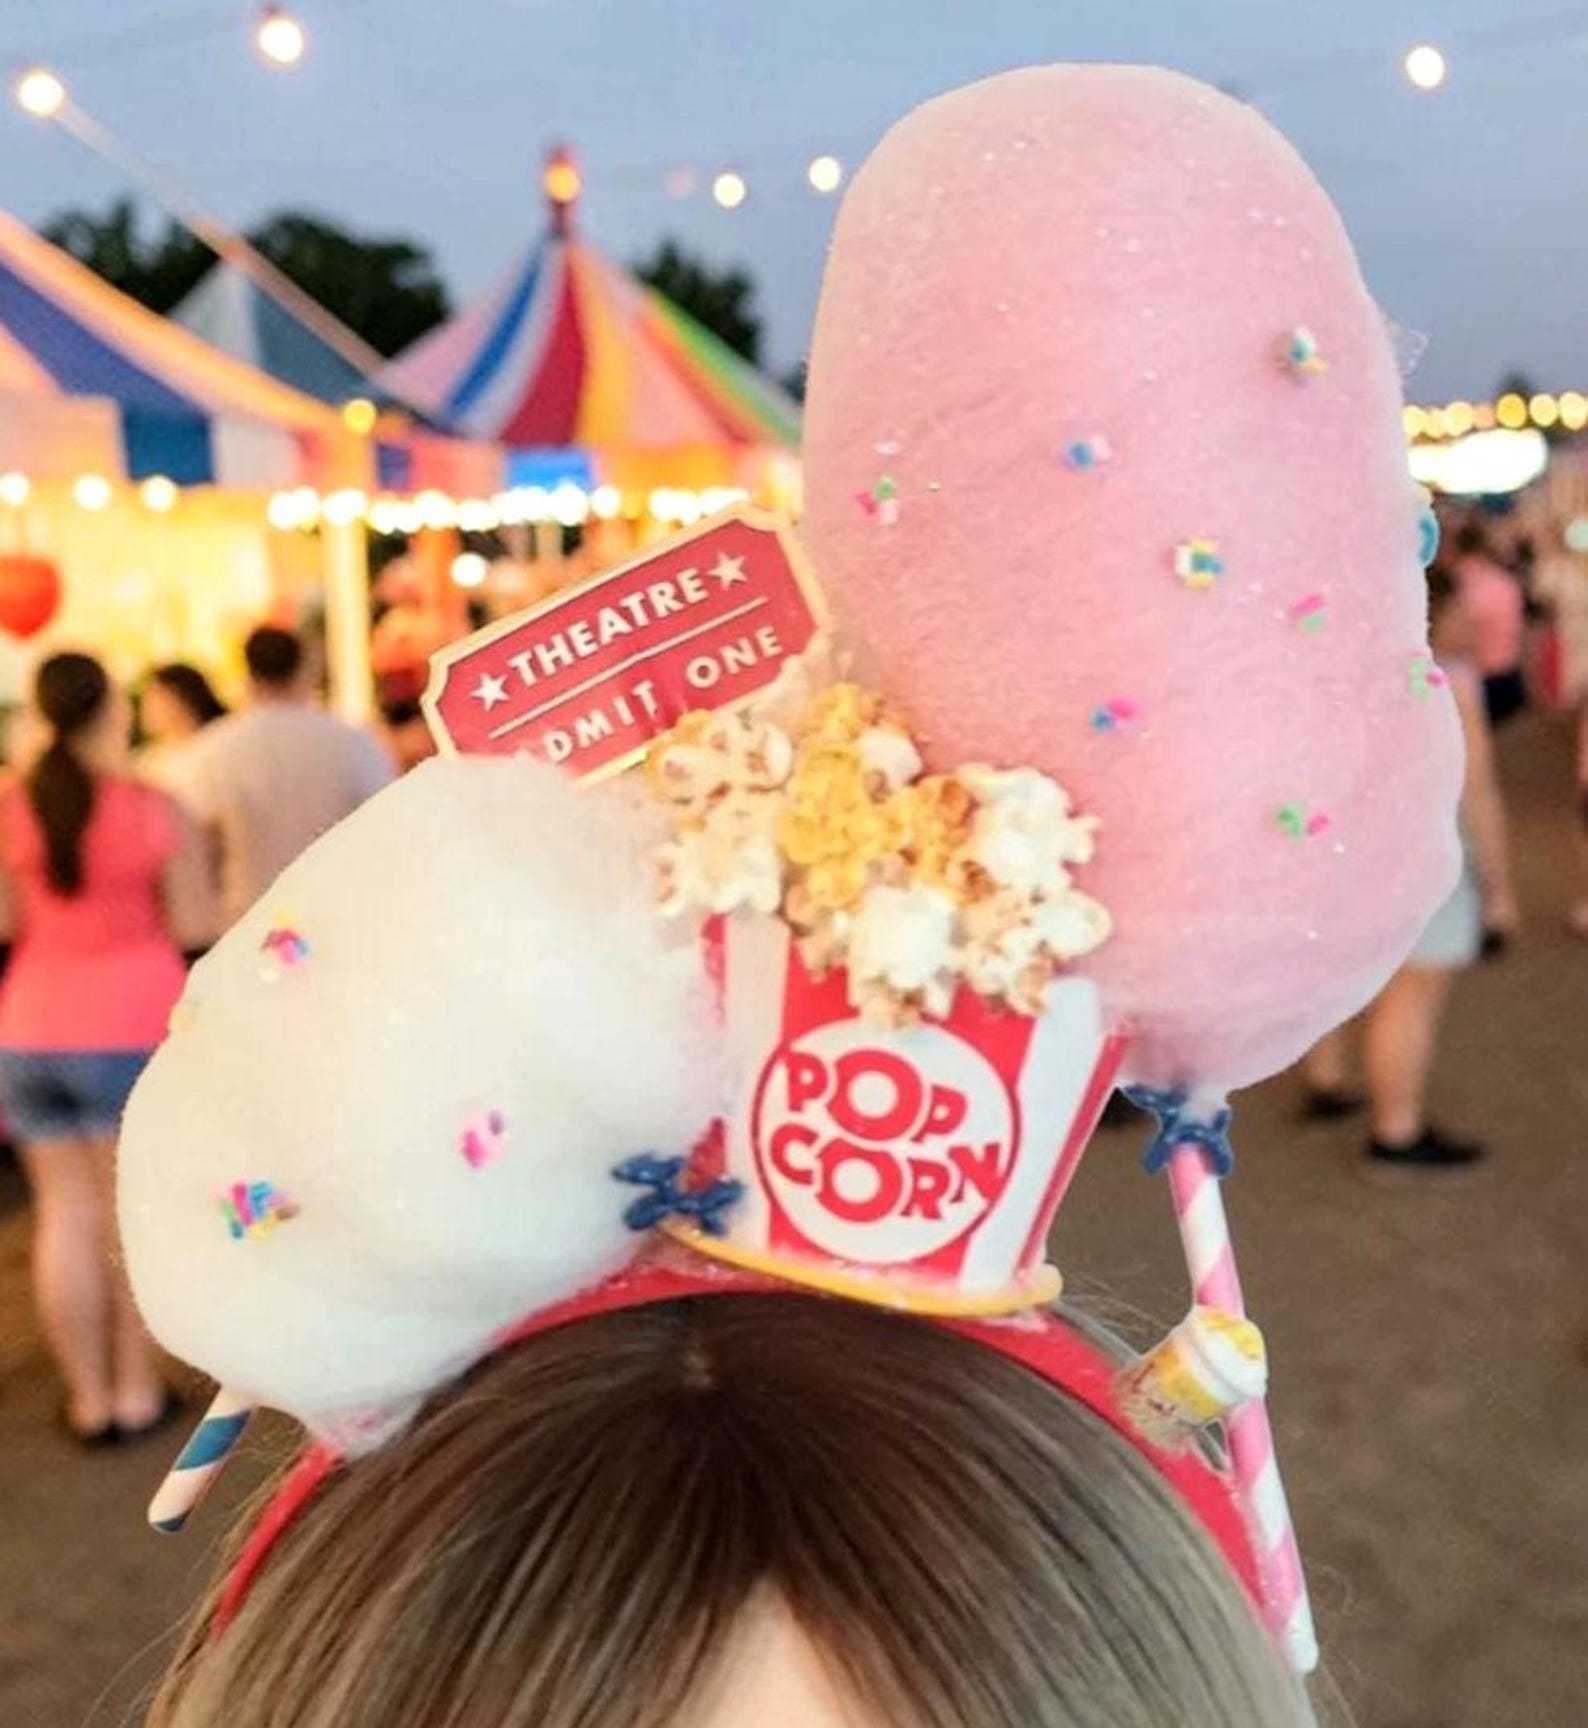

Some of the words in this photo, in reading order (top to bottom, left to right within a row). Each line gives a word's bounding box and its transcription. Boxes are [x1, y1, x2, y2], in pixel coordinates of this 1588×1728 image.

[508, 568, 710, 687] THEATRE
[516, 680, 657, 764] DMIT
[686, 626, 783, 688] ONE
[786, 1049, 968, 1142] POP
[769, 1137, 1002, 1223] CORN
